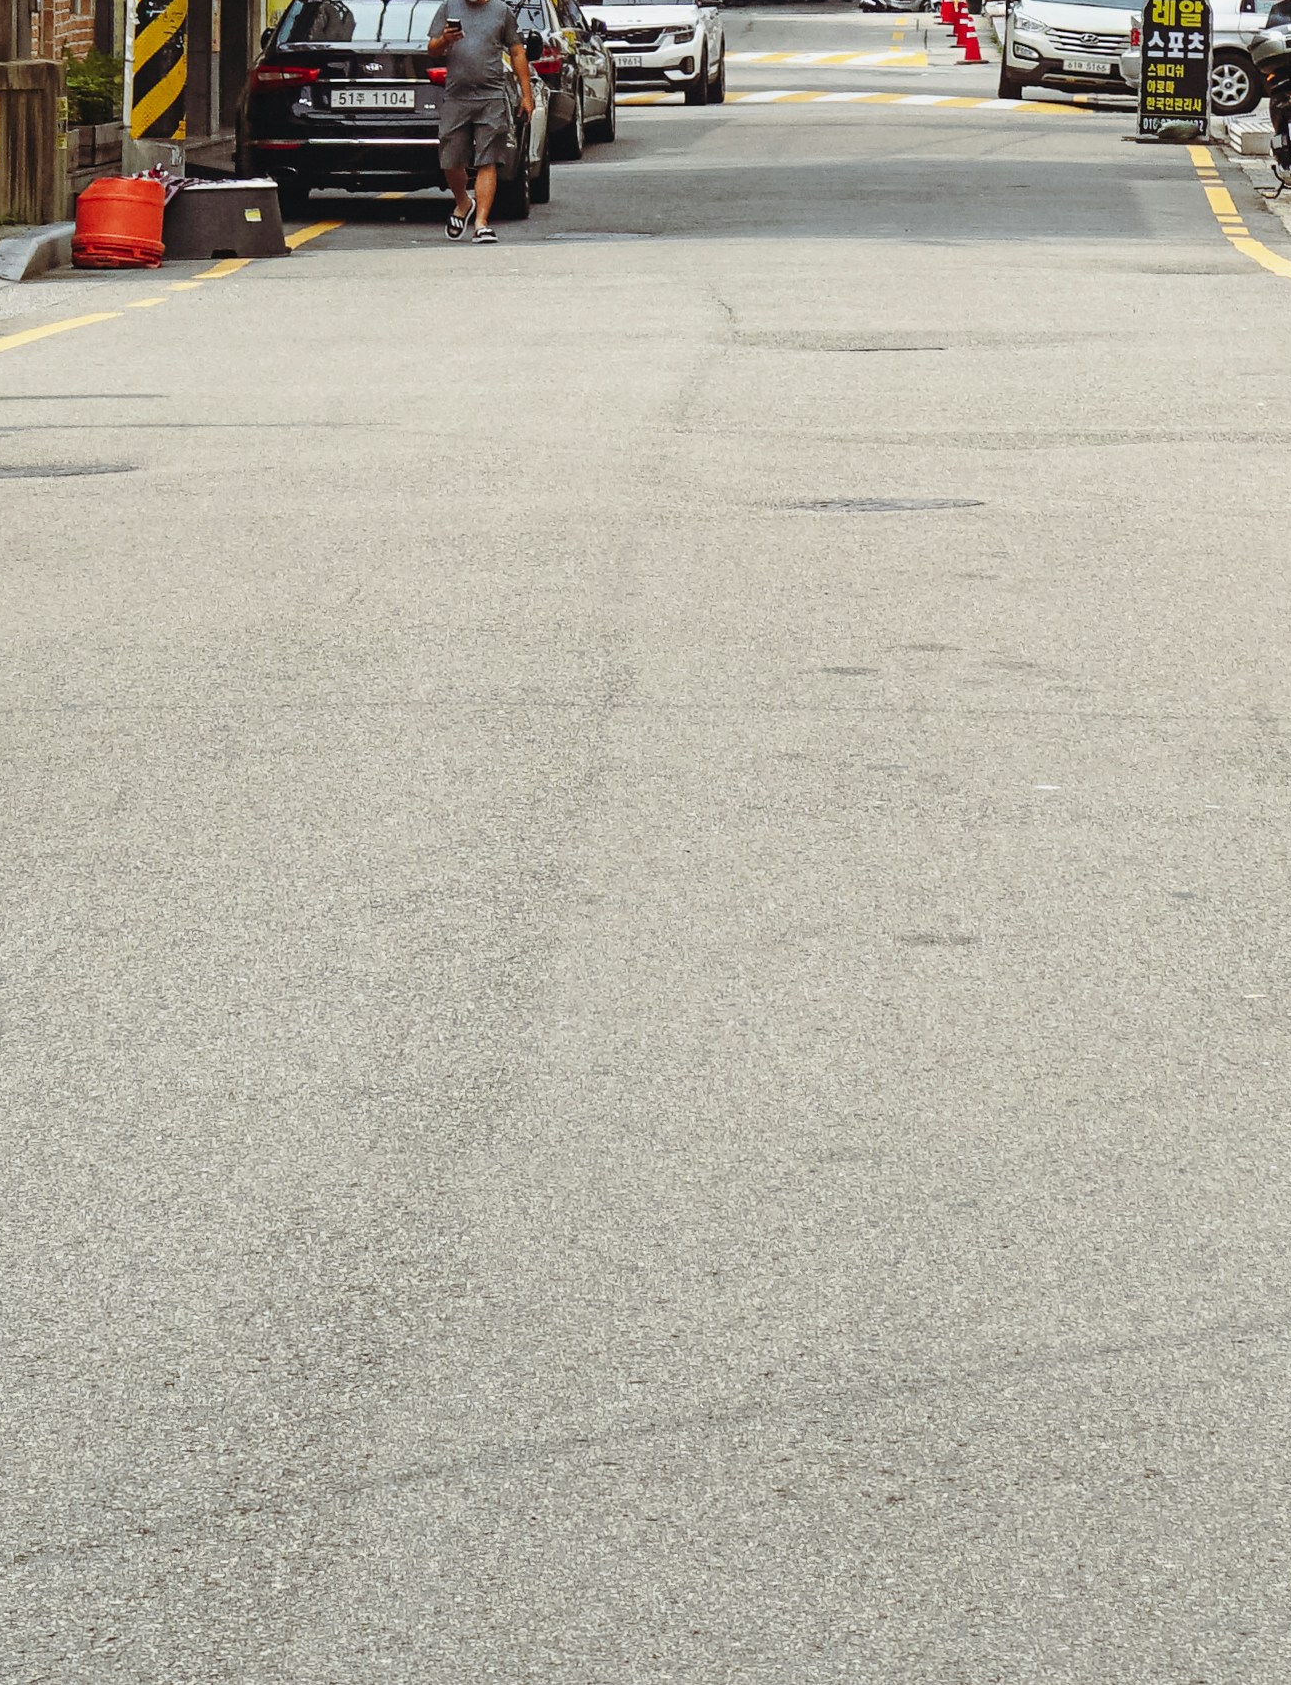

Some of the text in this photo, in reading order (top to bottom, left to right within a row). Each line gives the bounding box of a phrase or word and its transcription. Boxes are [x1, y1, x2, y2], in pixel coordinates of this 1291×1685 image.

[1152, 0, 1204, 27] 레알
[1147, 31, 1205, 59] 스포츠
[1146, 80, 1175, 94] 아로마
[338, 89, 408, 107] 51주 1104
[1146, 97, 1202, 112] 한국인관리사
